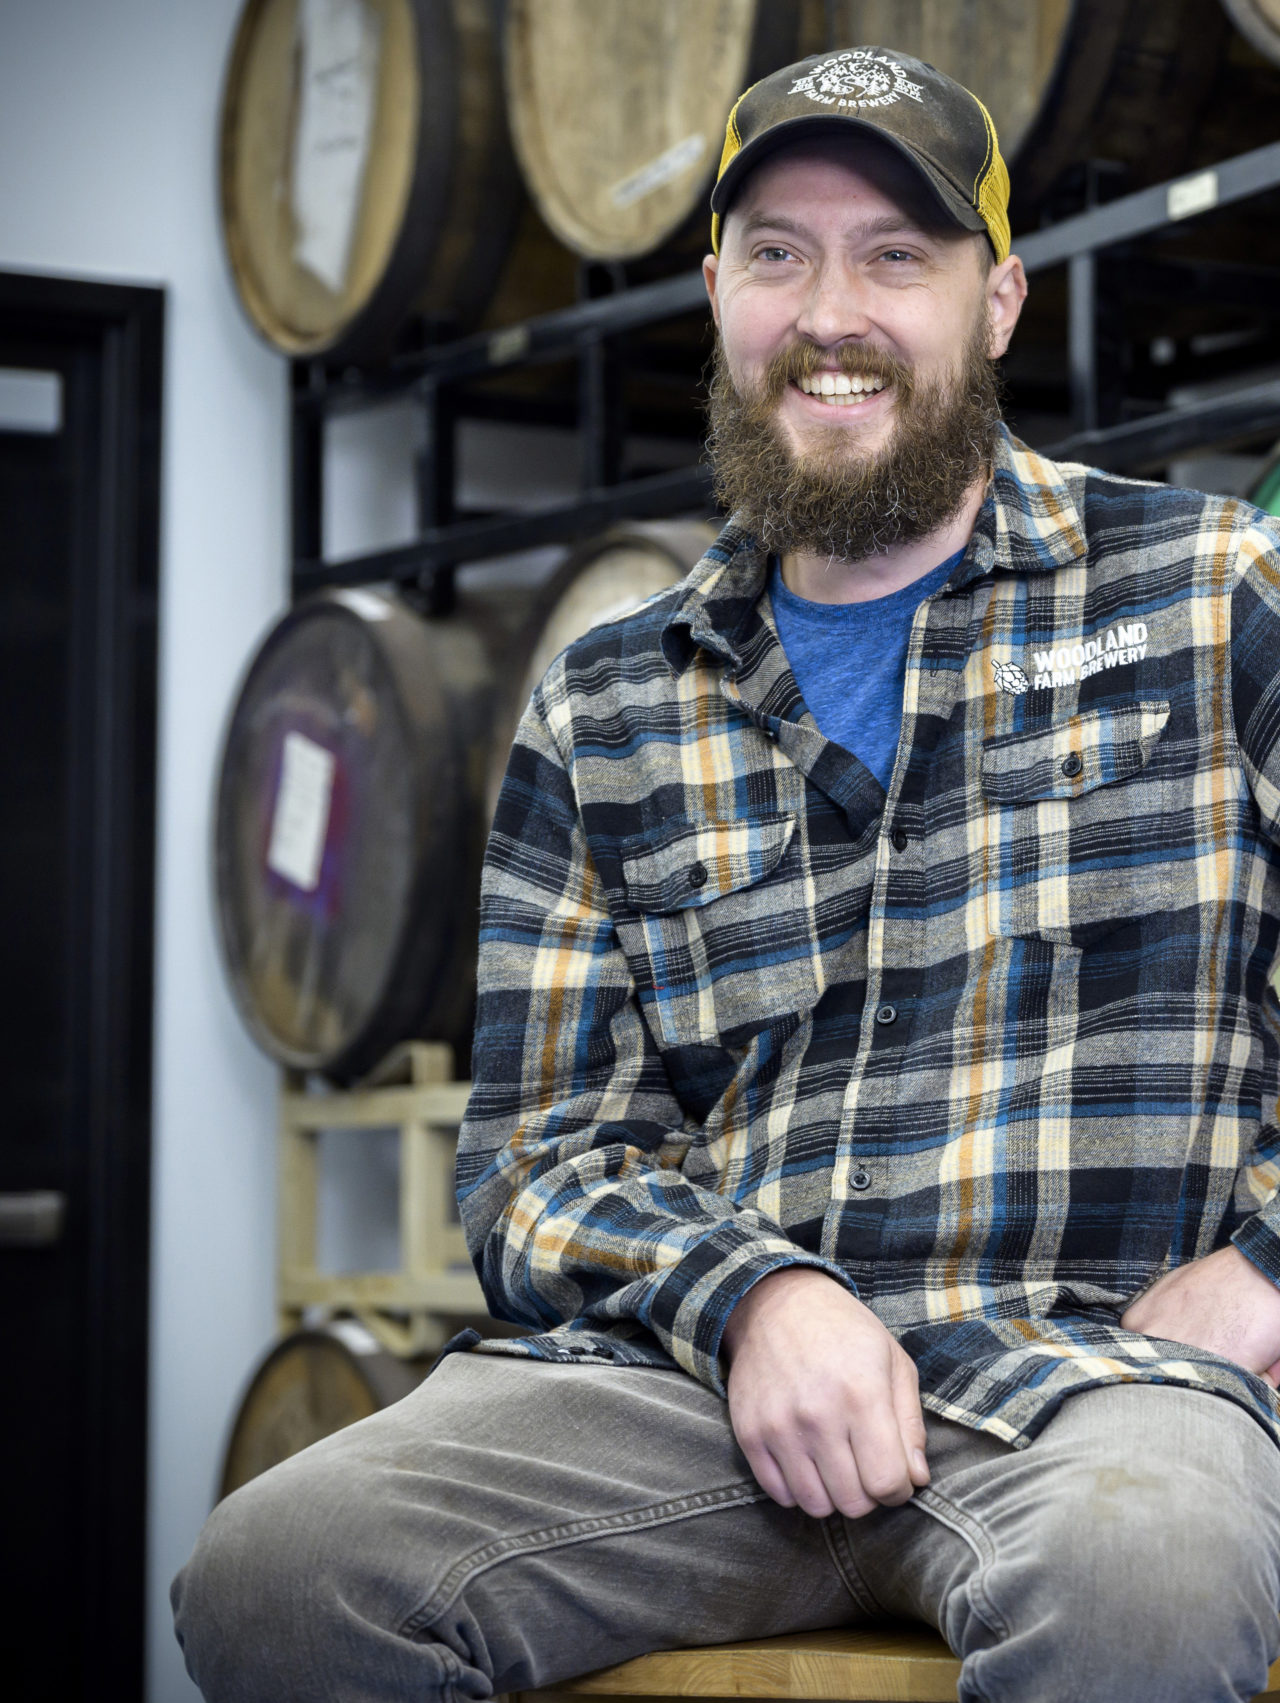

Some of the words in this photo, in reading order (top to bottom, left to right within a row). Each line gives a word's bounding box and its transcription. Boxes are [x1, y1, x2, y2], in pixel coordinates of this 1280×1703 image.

[809, 51, 907, 78] WOODLAND
[804, 88, 836, 105] FARM
[838, 90, 901, 108] BREWERY
[1033, 622, 1149, 673] WOODLAND
[1034, 669, 1076, 691] FARM
[1079, 643, 1147, 681] BREWERY
